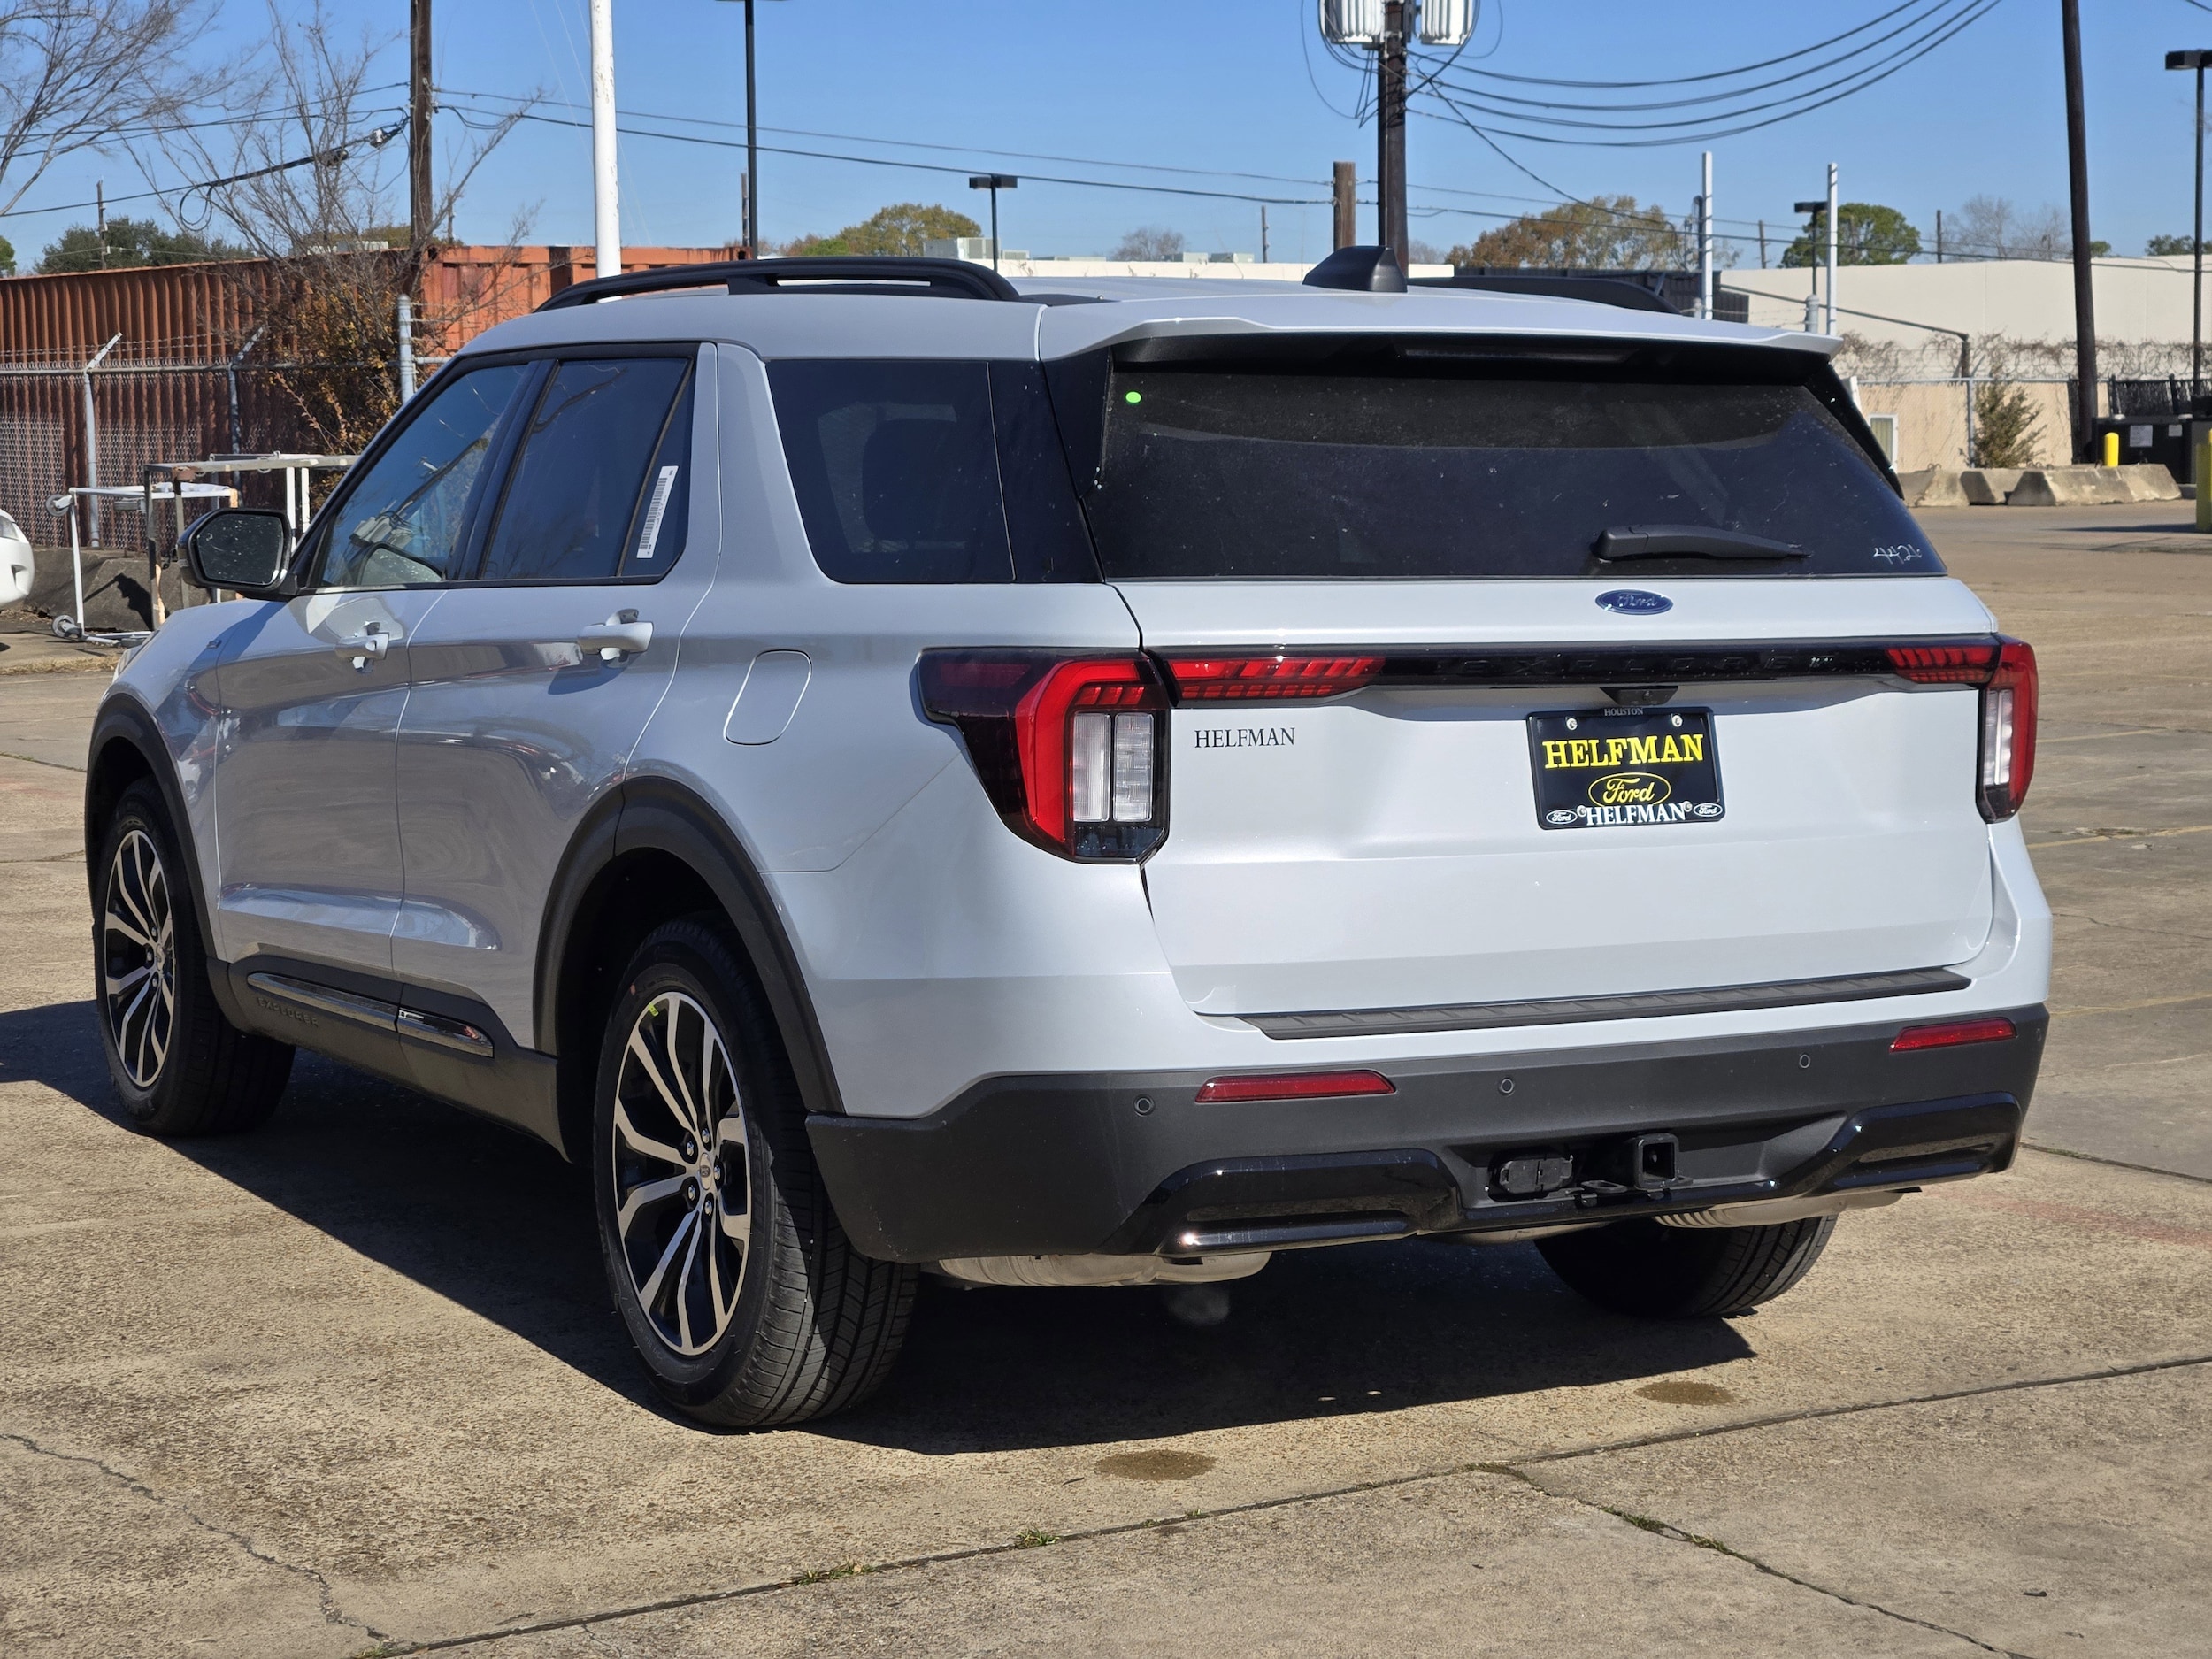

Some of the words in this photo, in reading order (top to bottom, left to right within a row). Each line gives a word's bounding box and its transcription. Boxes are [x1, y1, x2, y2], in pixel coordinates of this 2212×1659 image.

[1603, 708, 1644, 717] HOUSTON
[1194, 727, 1295, 749] HELFMAN
[1542, 733, 1704, 769] HELFMAN
[1602, 777, 1655, 803] Ford
[1551, 811, 1572, 822] Ford
[1586, 803, 1686, 826] HELFMAN
